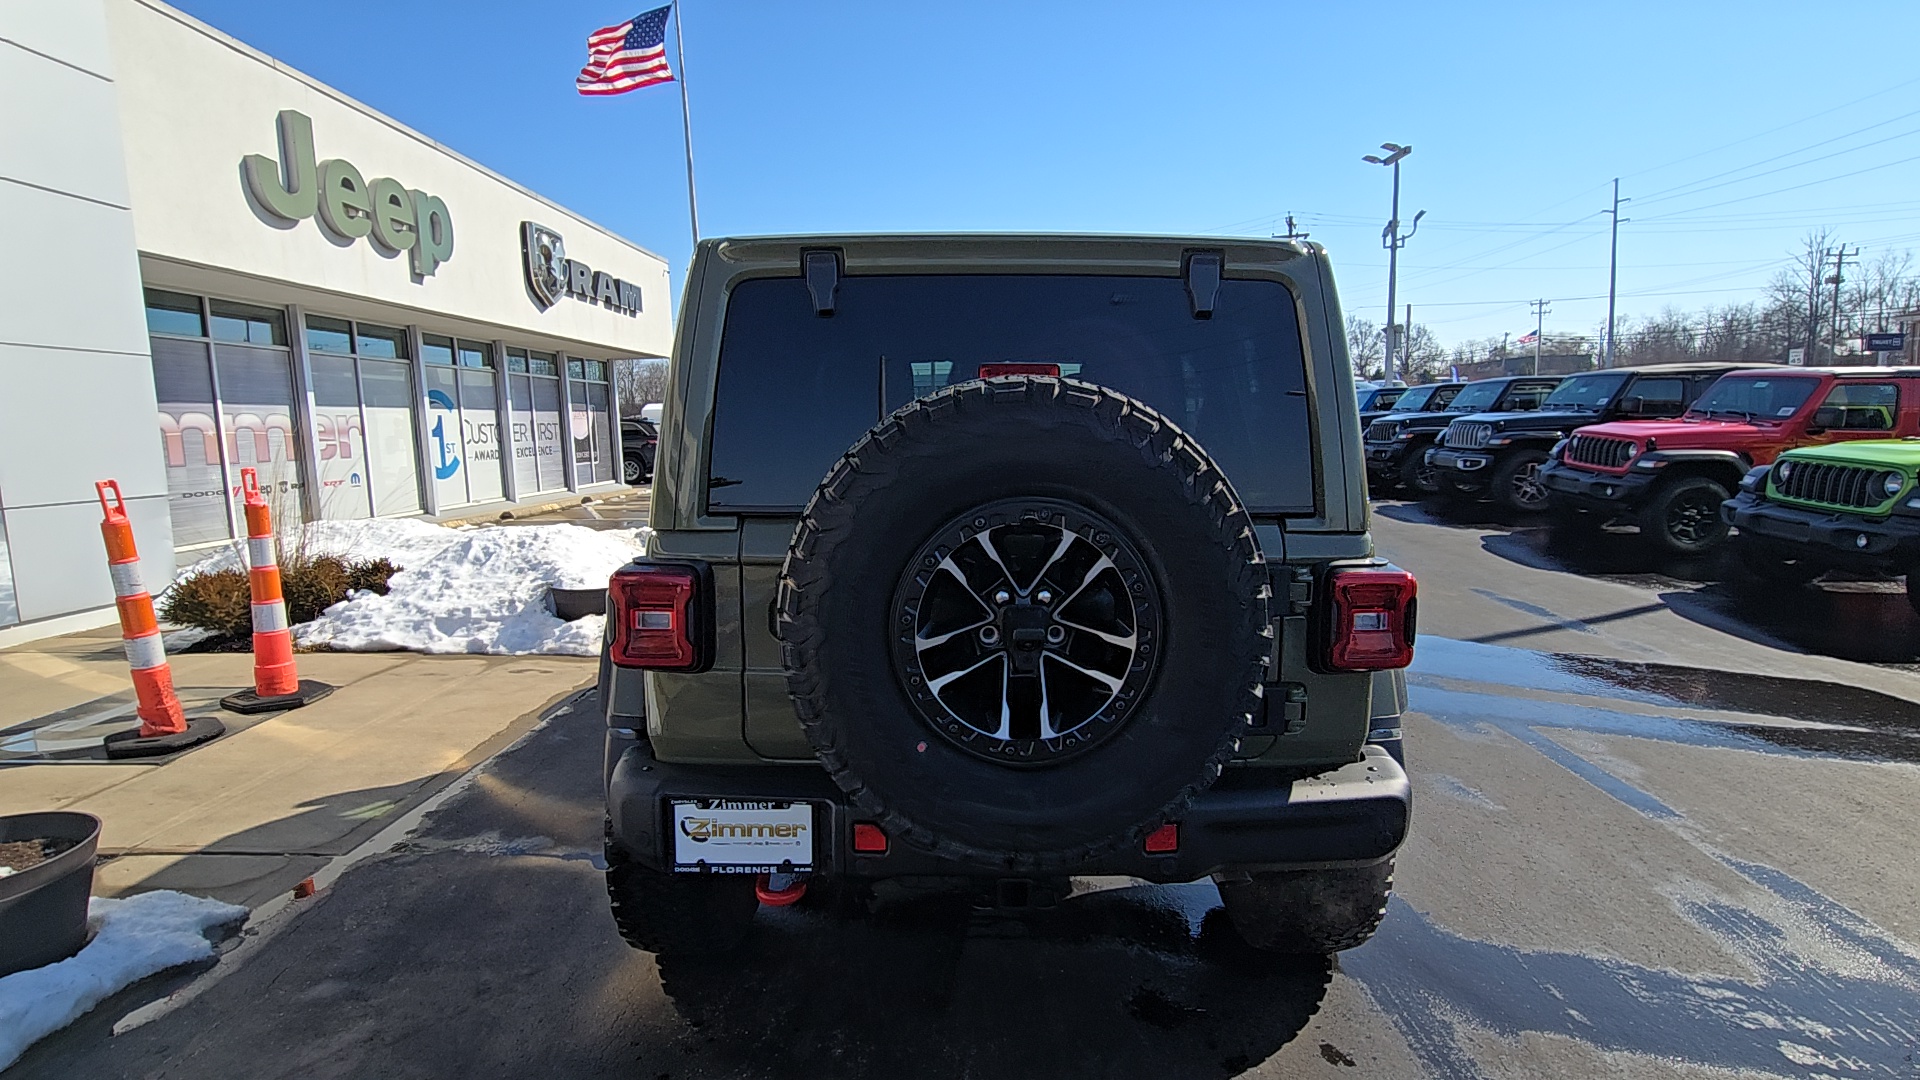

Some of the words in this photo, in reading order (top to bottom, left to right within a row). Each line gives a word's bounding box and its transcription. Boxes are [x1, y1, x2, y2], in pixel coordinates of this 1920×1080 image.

[240, 109, 454, 285] Jeep
[567, 259, 642, 314] RAM
[158, 411, 362, 467] mmer
[464, 419, 528, 445] CUSTOER
[516, 446, 553, 458] EXCELENCE
[182, 489, 226, 499] DODG
[709, 799, 775, 810] Zimmer
[688, 818, 807, 838] Zimmer
[711, 866, 777, 874] FLORENCE
